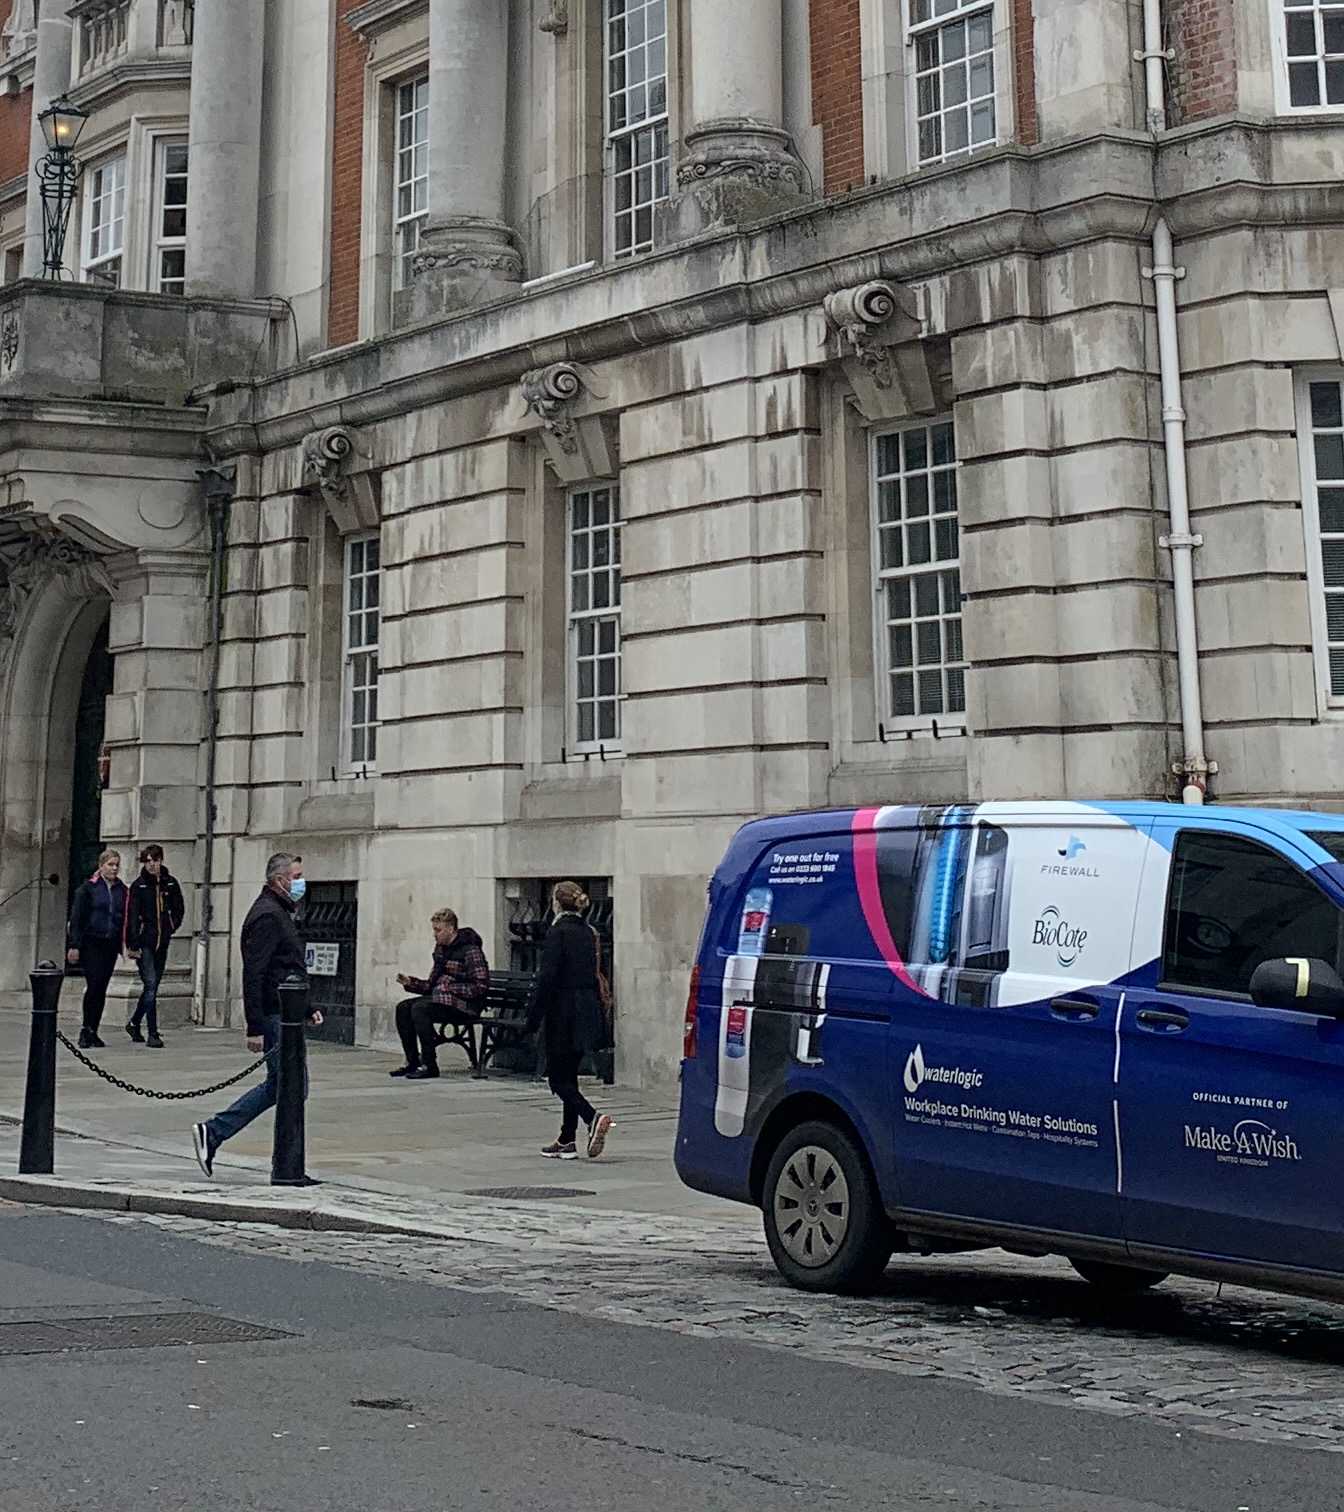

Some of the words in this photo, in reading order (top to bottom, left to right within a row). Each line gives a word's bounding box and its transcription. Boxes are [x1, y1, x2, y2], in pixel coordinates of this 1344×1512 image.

[773, 853, 784, 864] Try
[785, 854, 798, 862] one
[799, 853, 812, 862] out
[813, 852, 824, 862] for
[824, 852, 839, 862] free
[1040, 865, 1100, 877] FIREWALL
[1032, 919, 1088, 949] BioCote
[924, 1067, 983, 1089] waterlogic
[1193, 1092, 1231, 1104] OFFICIAL
[1234, 1097, 1273, 1108] PARTNER
[1276, 1101, 1288, 1109] OF
[904, 1097, 958, 1117] Workplace
[961, 1104, 1006, 1126] Drinking
[1008, 1110, 1041, 1127] Water
[1044, 1115, 1098, 1136] Solutions
